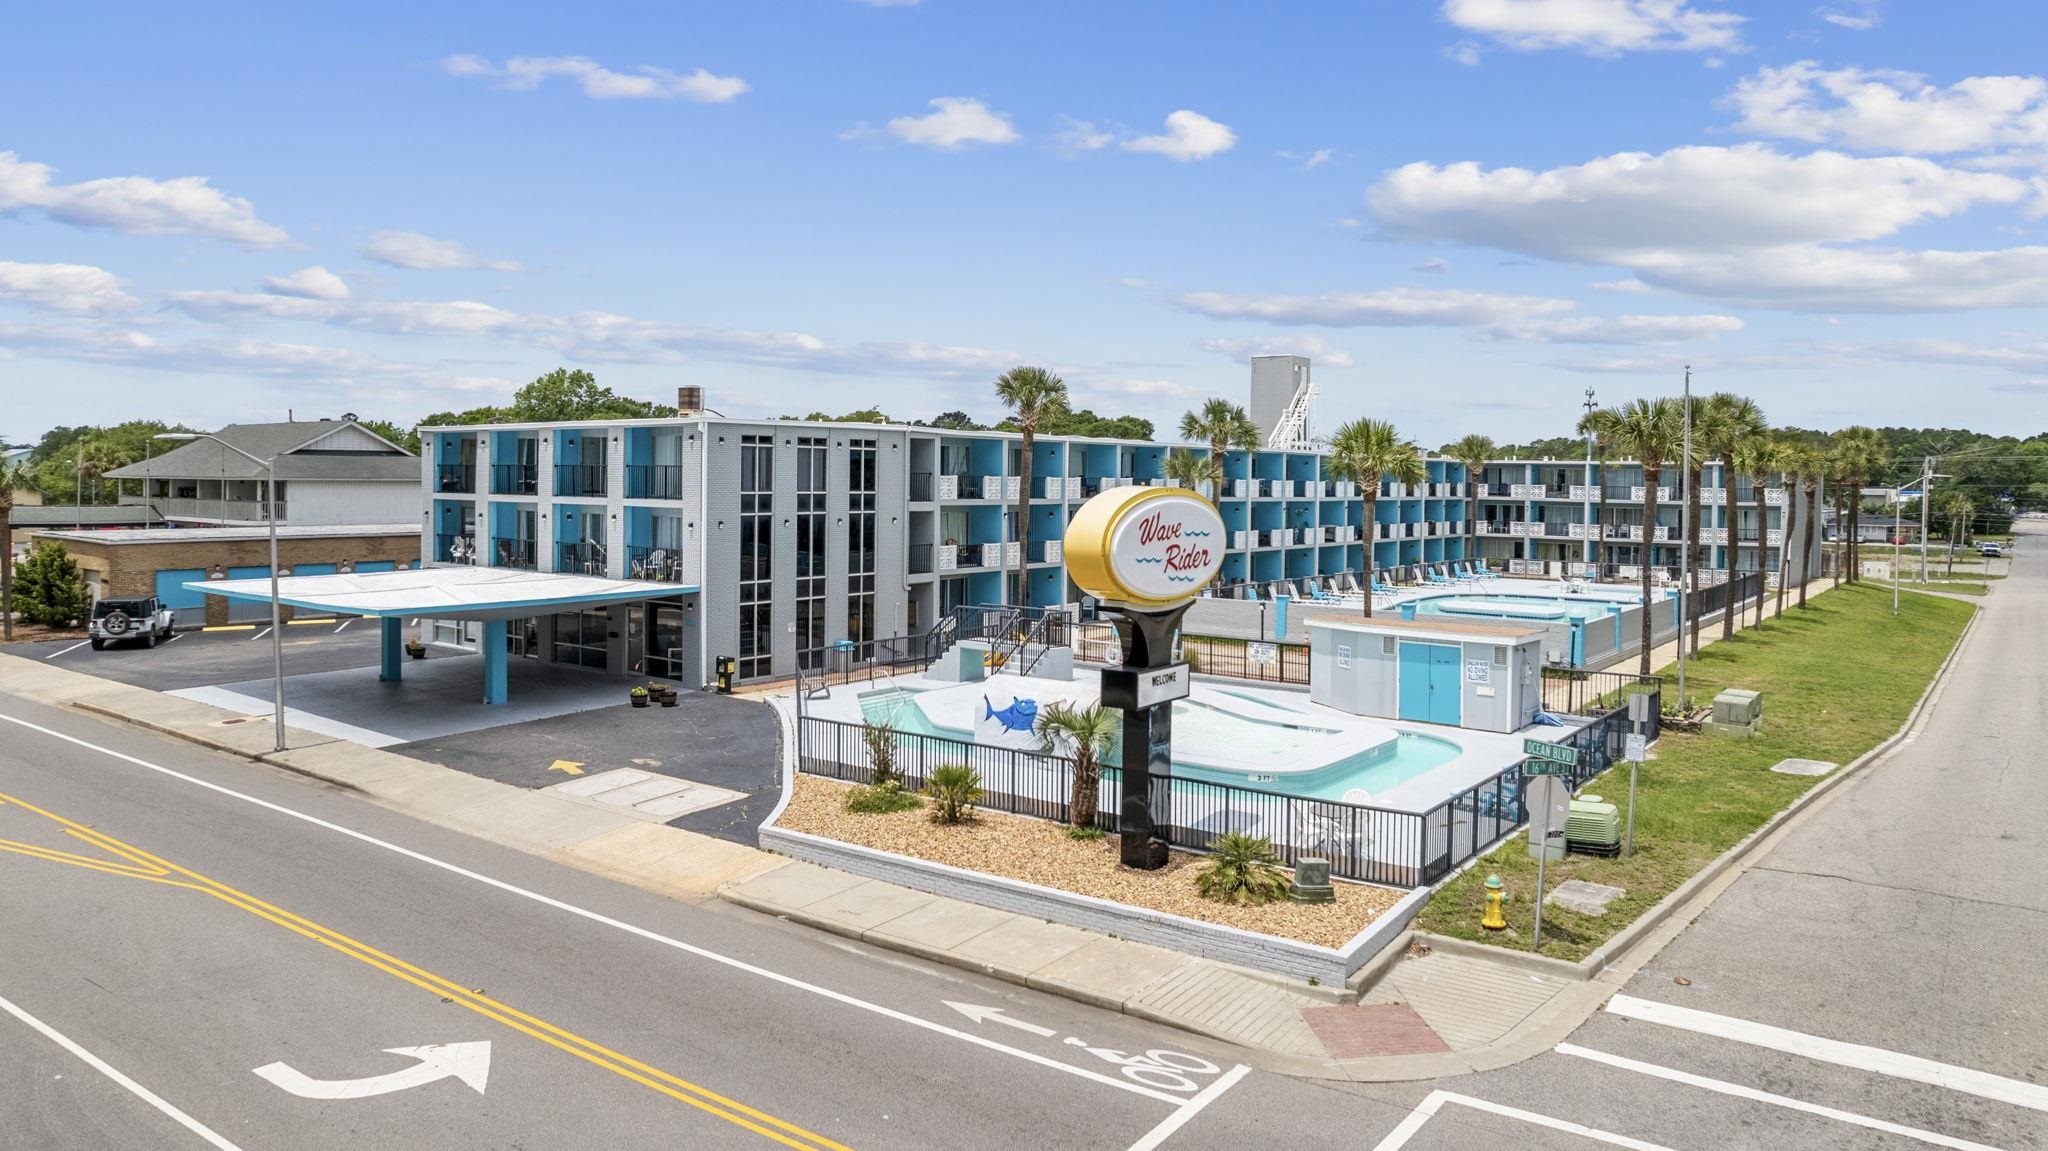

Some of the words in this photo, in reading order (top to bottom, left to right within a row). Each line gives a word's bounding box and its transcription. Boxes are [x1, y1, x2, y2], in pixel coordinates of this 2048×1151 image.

[1139, 511, 1182, 546] Wave
[1164, 543, 1211, 573] Rider
[1468, 673, 1488, 681] ALLOWED
[1474, 666, 1488, 674] DIVING
[1152, 672, 1177, 687] WELCOME
[1527, 741, 1551, 758] OCEAN
[1553, 747, 1572, 761] BLVD
[1548, 762, 1560, 774] AVE
